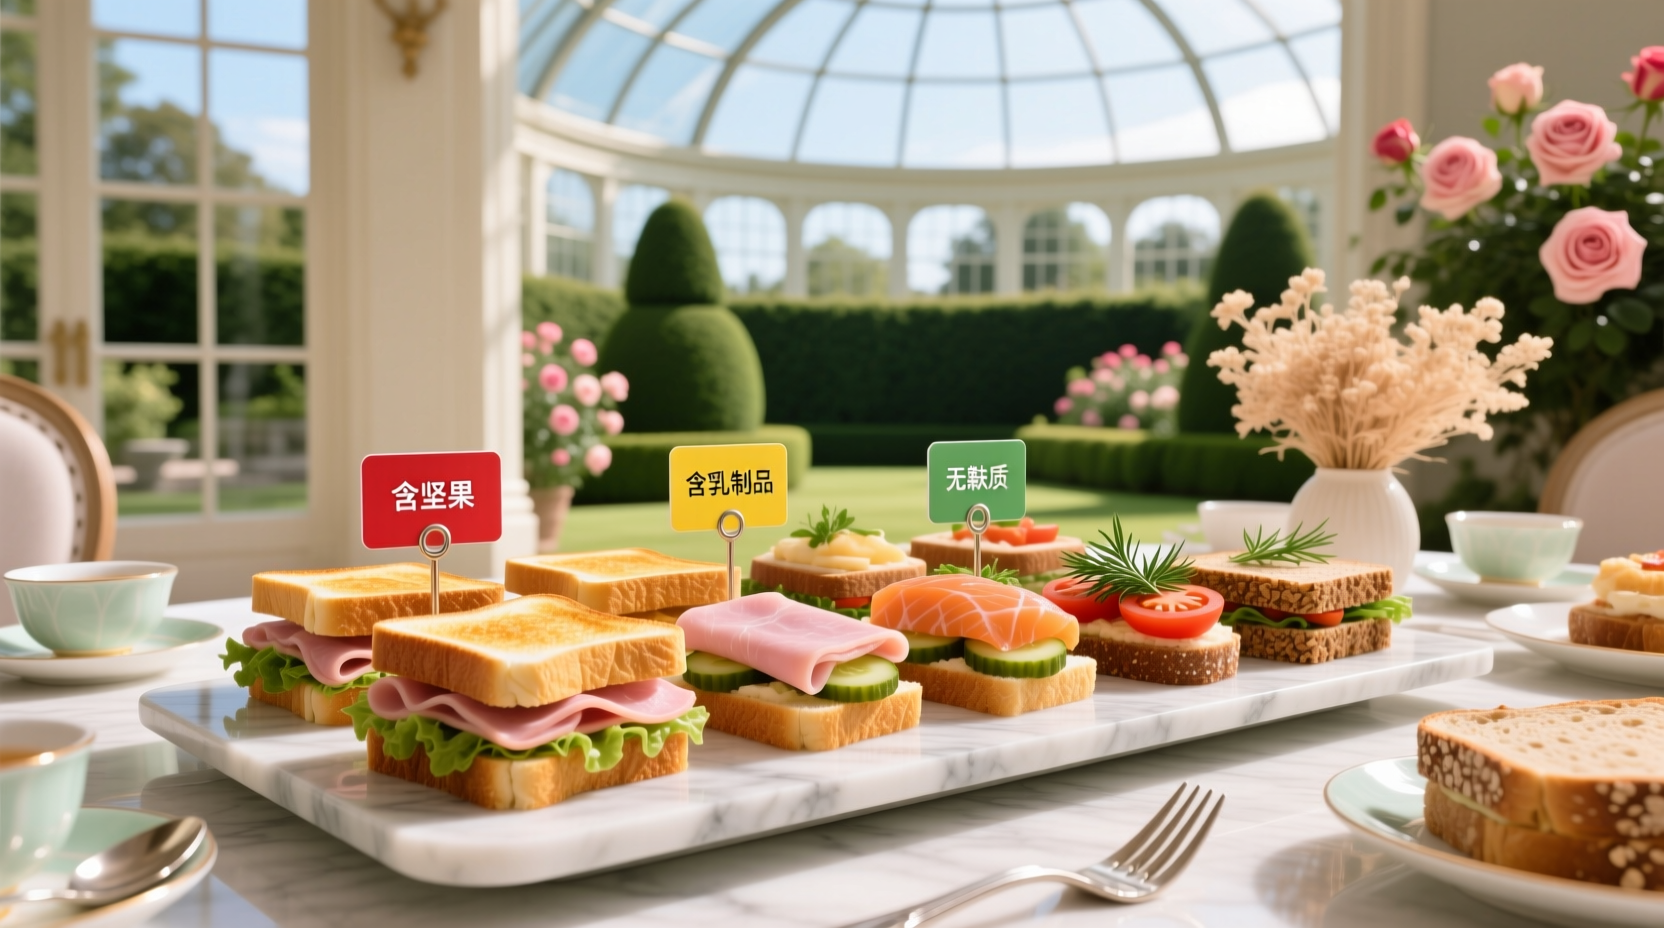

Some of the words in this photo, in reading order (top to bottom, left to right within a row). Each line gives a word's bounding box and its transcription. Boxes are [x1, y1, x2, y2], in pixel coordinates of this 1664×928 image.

[391, 480, 475, 512] 含坚果
[685, 469, 773, 498] 含乳制品
